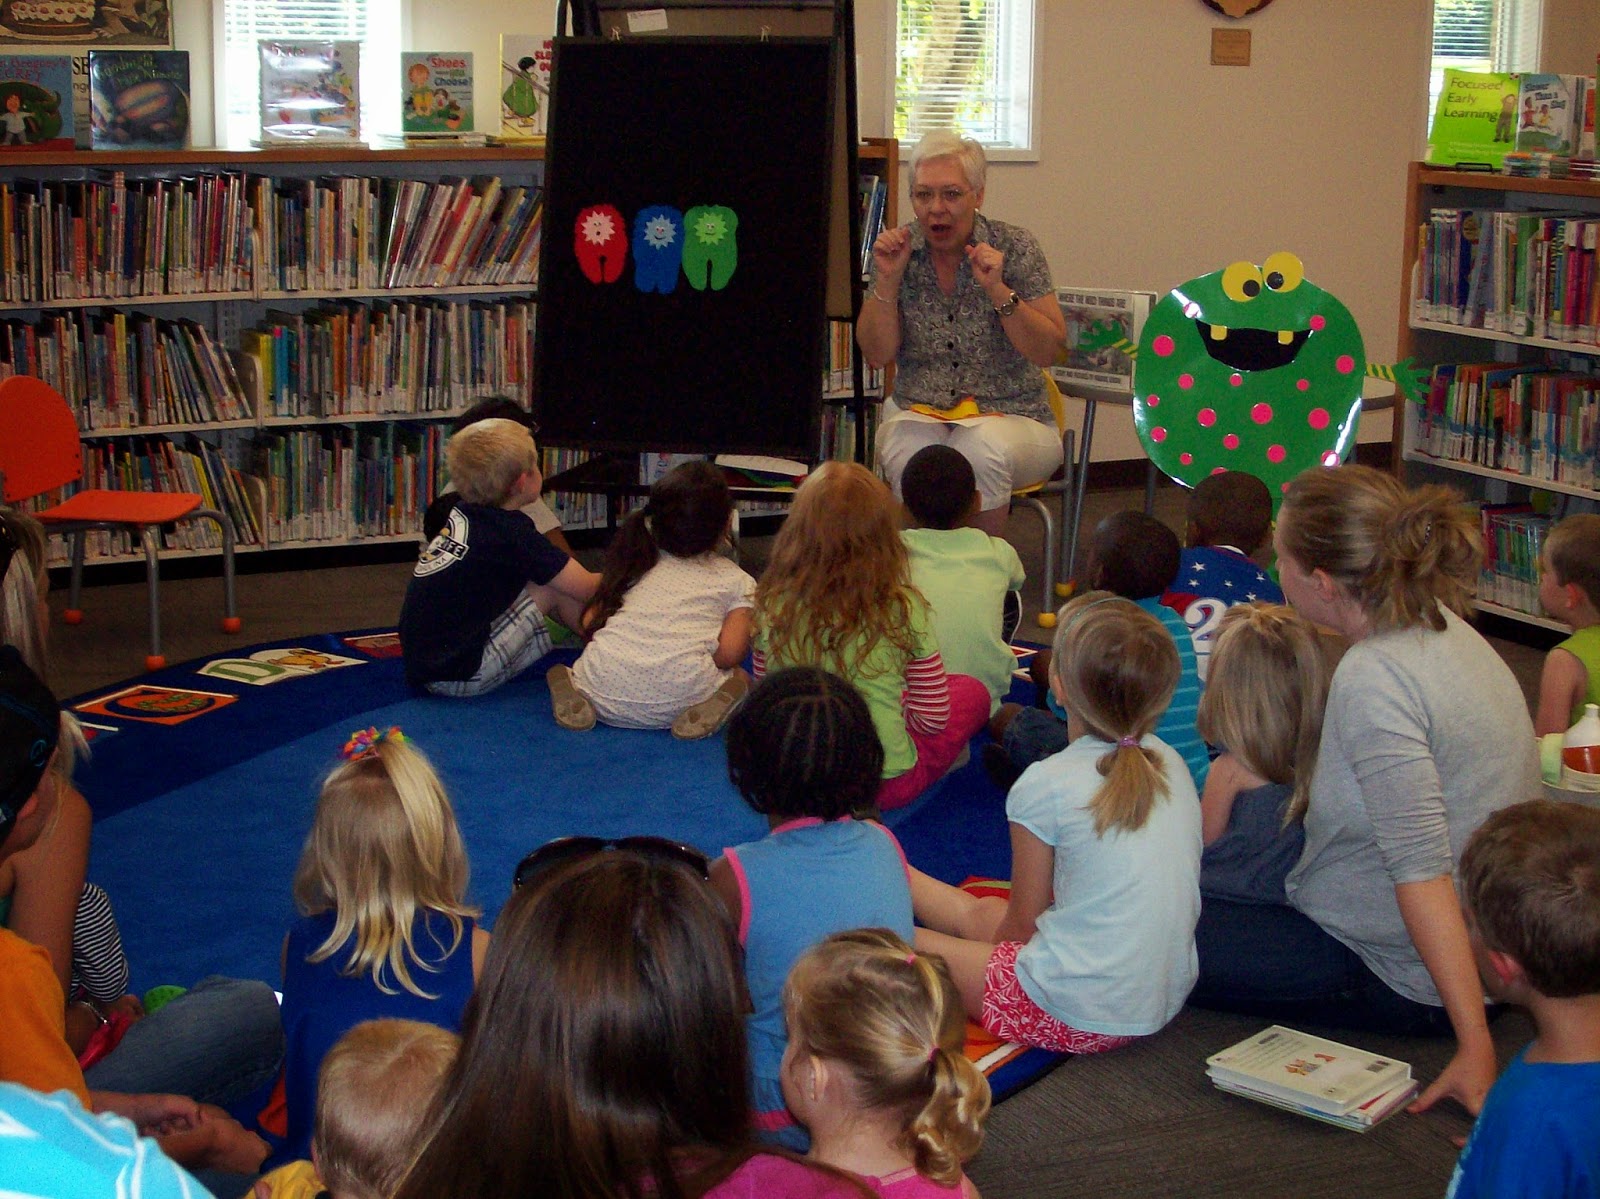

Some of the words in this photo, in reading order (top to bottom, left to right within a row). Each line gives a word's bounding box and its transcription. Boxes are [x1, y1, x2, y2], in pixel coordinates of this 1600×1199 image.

[431, 57, 466, 68] Shoes
[1451, 78, 1504, 90] Focused
[1448, 92, 1477, 106] Early
[1444, 108, 1498, 122] Learning
[1184, 597, 1232, 653] 2
